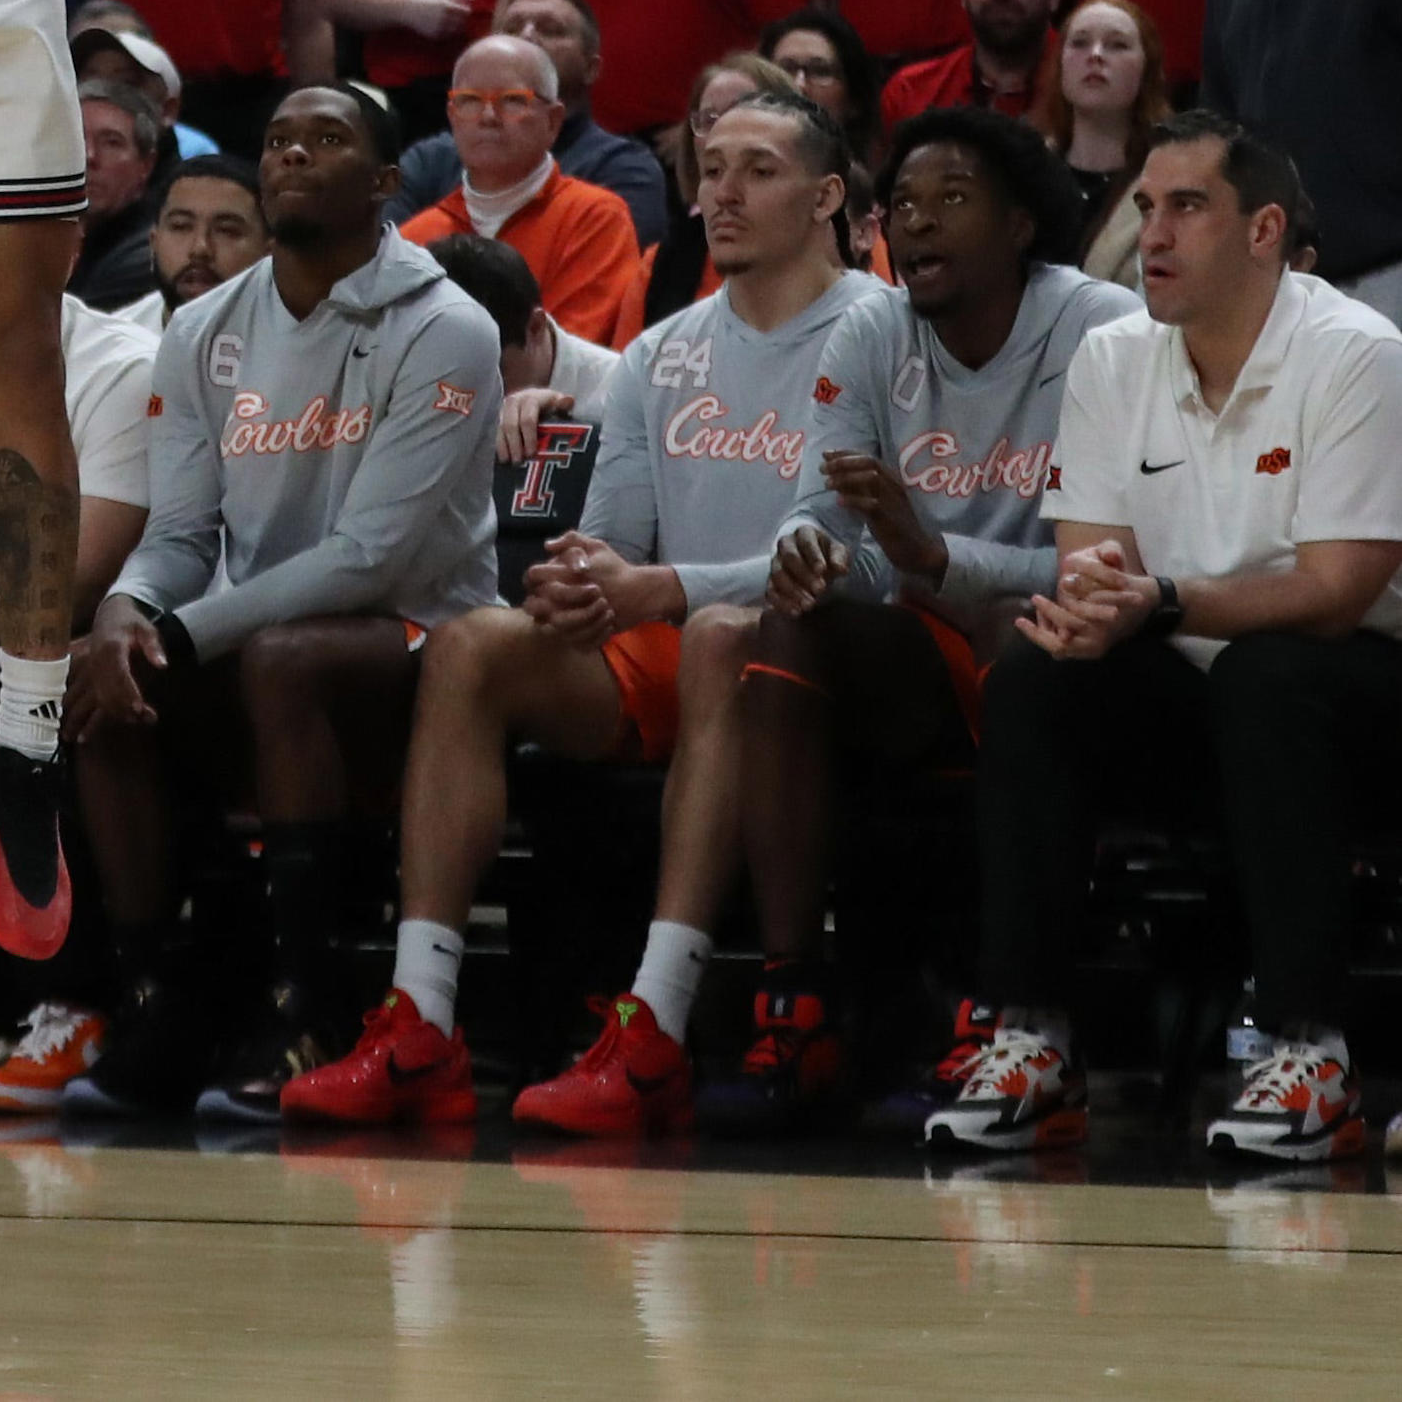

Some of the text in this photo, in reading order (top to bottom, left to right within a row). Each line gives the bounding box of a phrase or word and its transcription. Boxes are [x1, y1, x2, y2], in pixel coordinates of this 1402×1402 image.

[208, 334, 242, 388] 6
[650, 336, 714, 390] 24
[221, 389, 372, 459] Cowbos
[665, 393, 805, 480] Cowboy
[898, 430, 1053, 499] Cowboy
